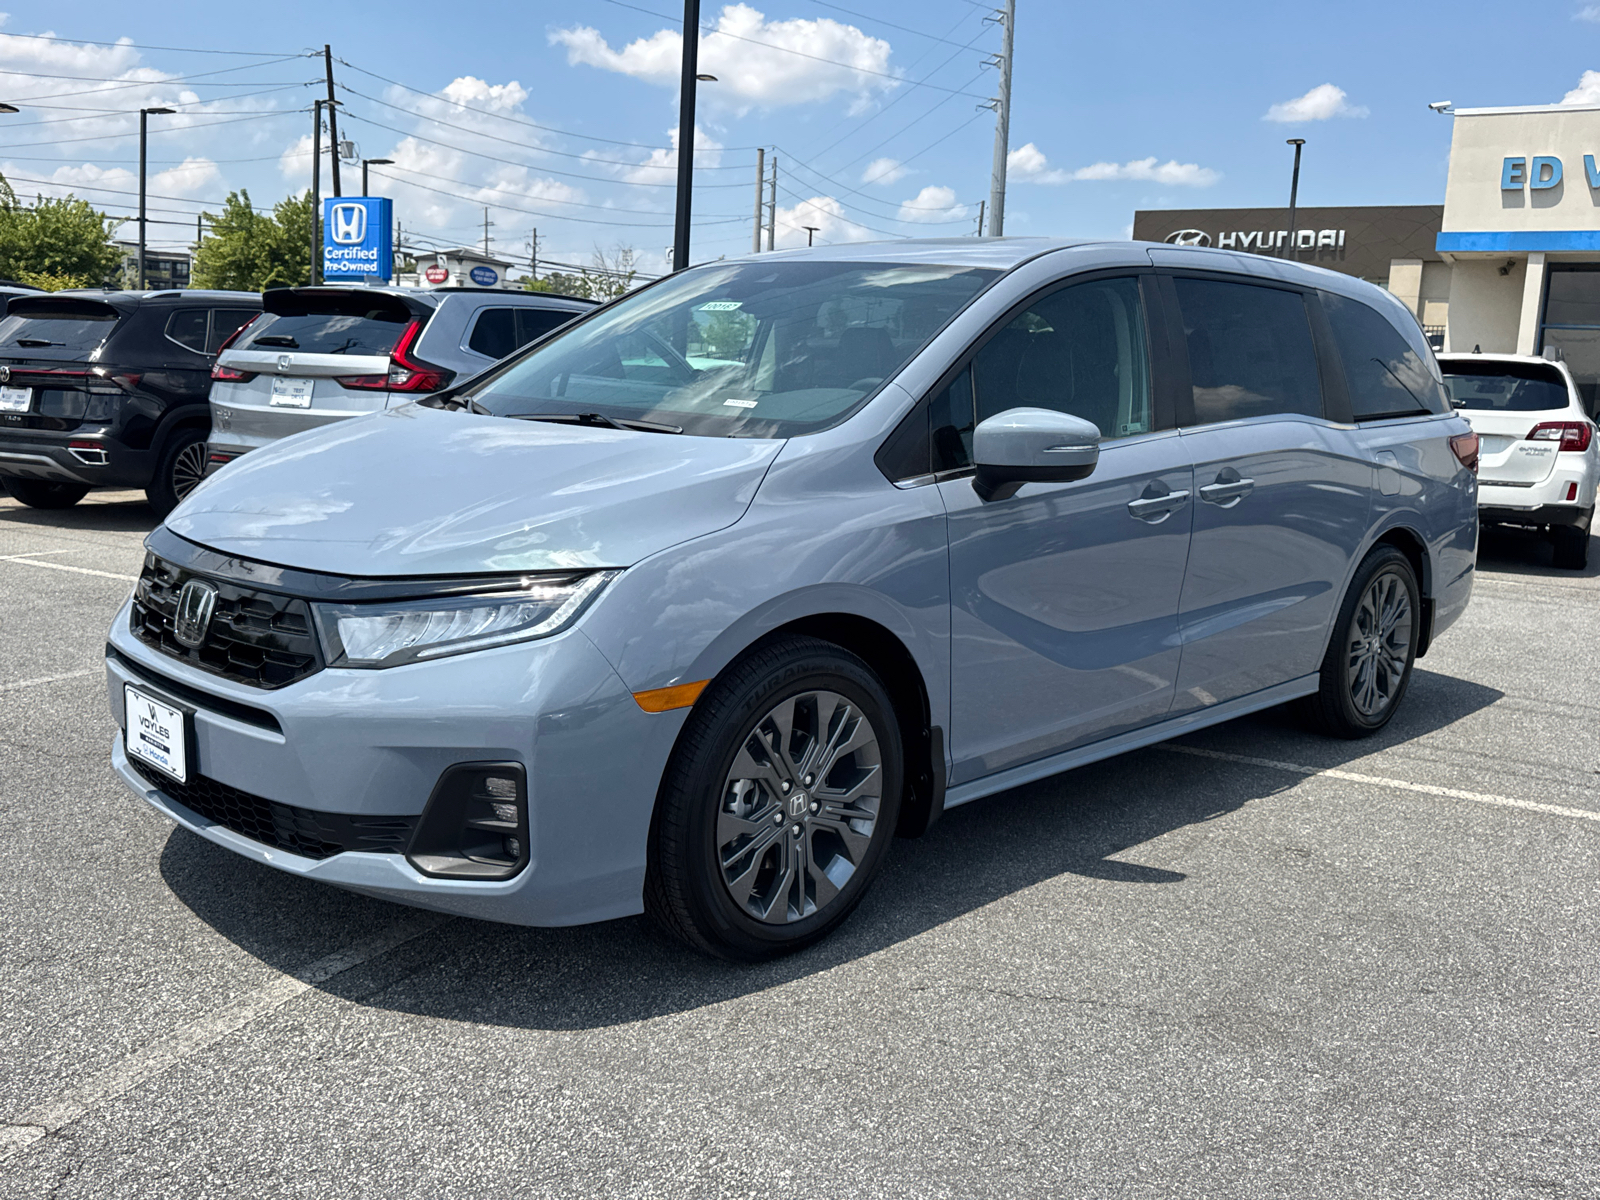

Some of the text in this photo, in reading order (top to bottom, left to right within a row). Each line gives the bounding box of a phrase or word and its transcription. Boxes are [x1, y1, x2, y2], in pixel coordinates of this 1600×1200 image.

[1501, 156, 1563, 190] ED
[1218, 230, 1346, 249] HYUNDAI
[324, 247, 377, 259] Certified
[324, 261, 377, 272] Pre-Owned
[139, 715, 170, 739] VOYLES
[149, 747, 168, 765] Honda
